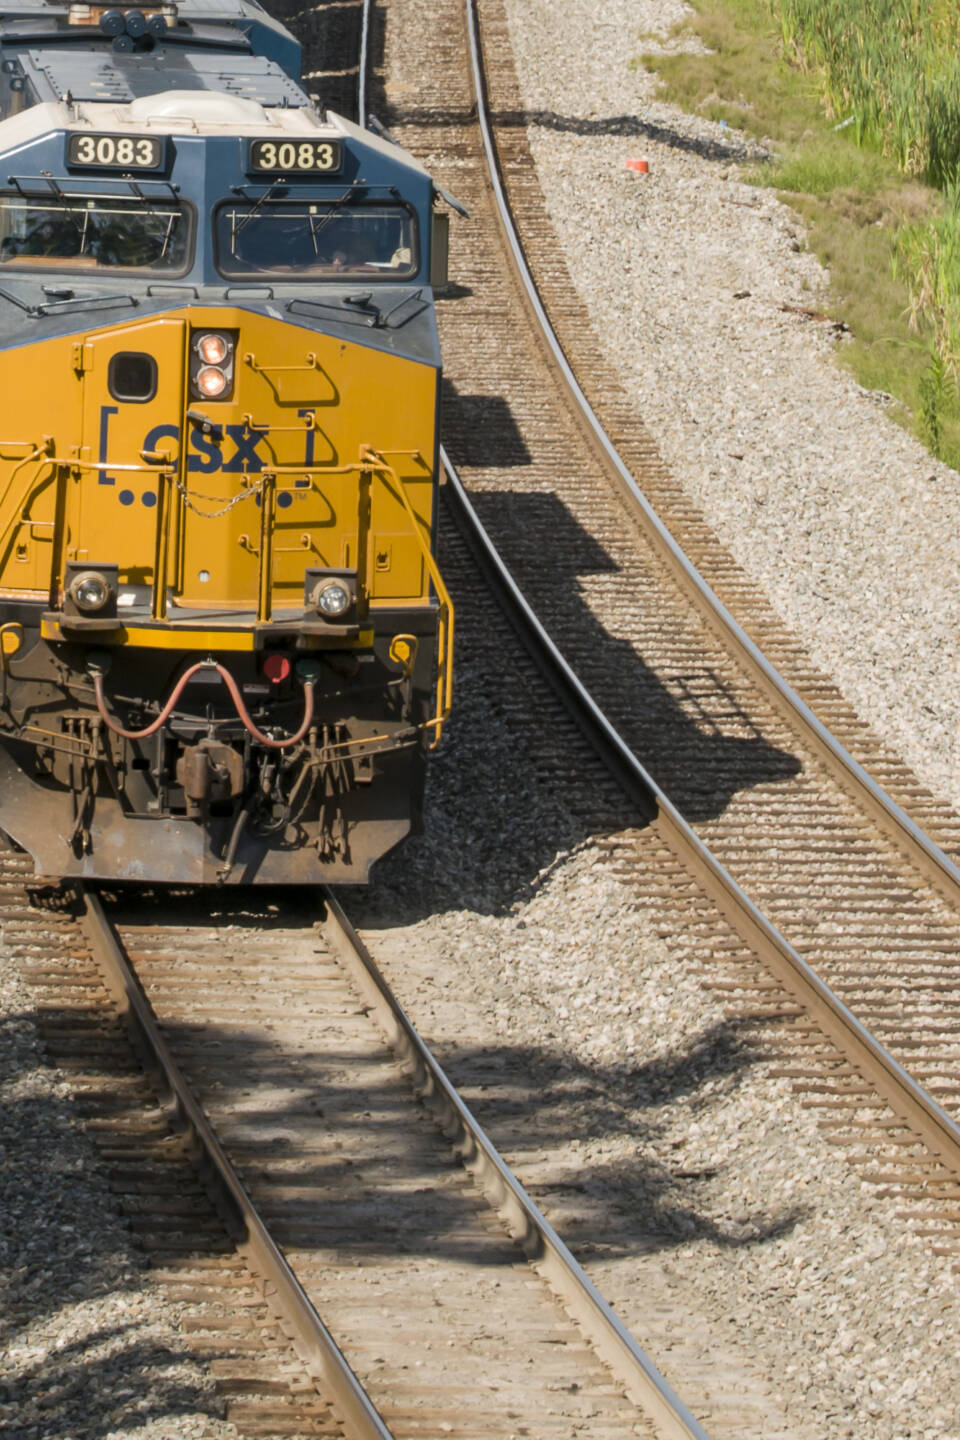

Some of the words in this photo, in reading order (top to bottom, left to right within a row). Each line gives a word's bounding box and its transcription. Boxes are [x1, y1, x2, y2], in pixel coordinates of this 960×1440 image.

[77, 136, 154, 165] 3083
[259, 143, 334, 169] 3083
[143, 424, 269, 474] CSX
